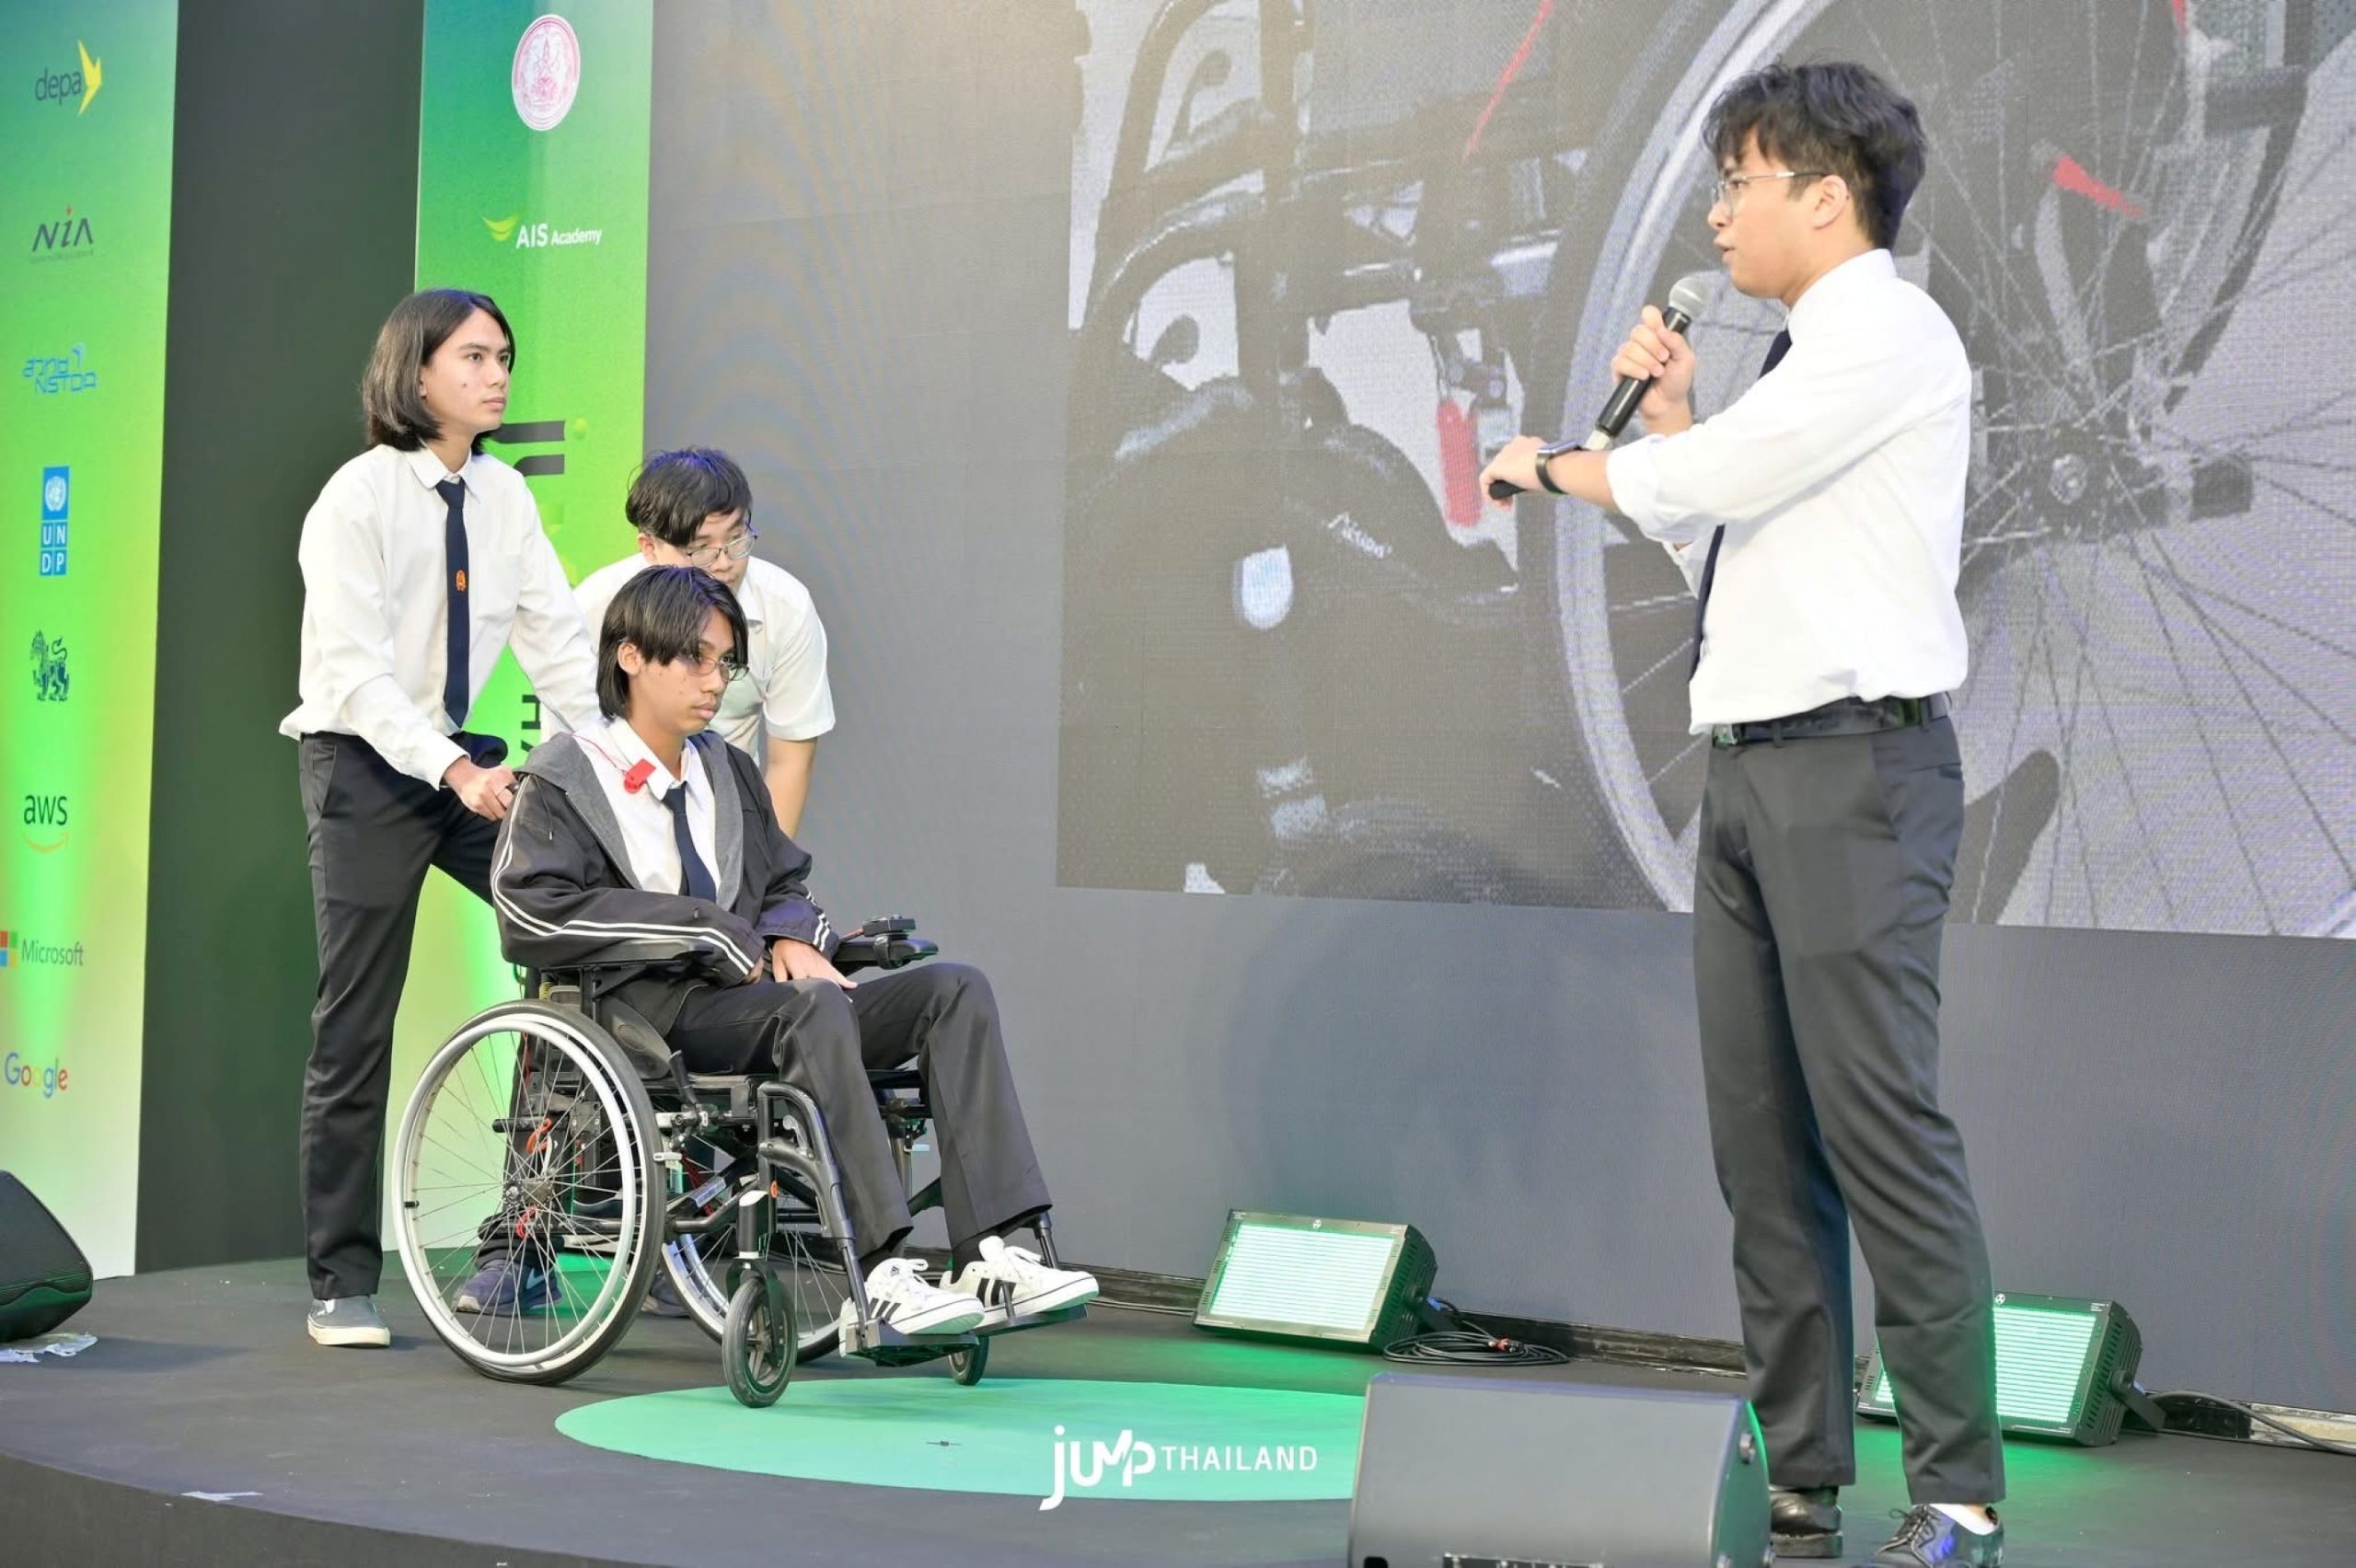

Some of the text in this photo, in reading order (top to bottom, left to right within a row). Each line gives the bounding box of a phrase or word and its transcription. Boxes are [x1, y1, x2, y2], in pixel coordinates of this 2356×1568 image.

[35, 68, 82, 106] depa
[515, 224, 603, 248] AIS Academy
[23, 794, 68, 825] aws
[21, 940, 84, 967] Microsoft
[5, 1052, 69, 1099] Google
